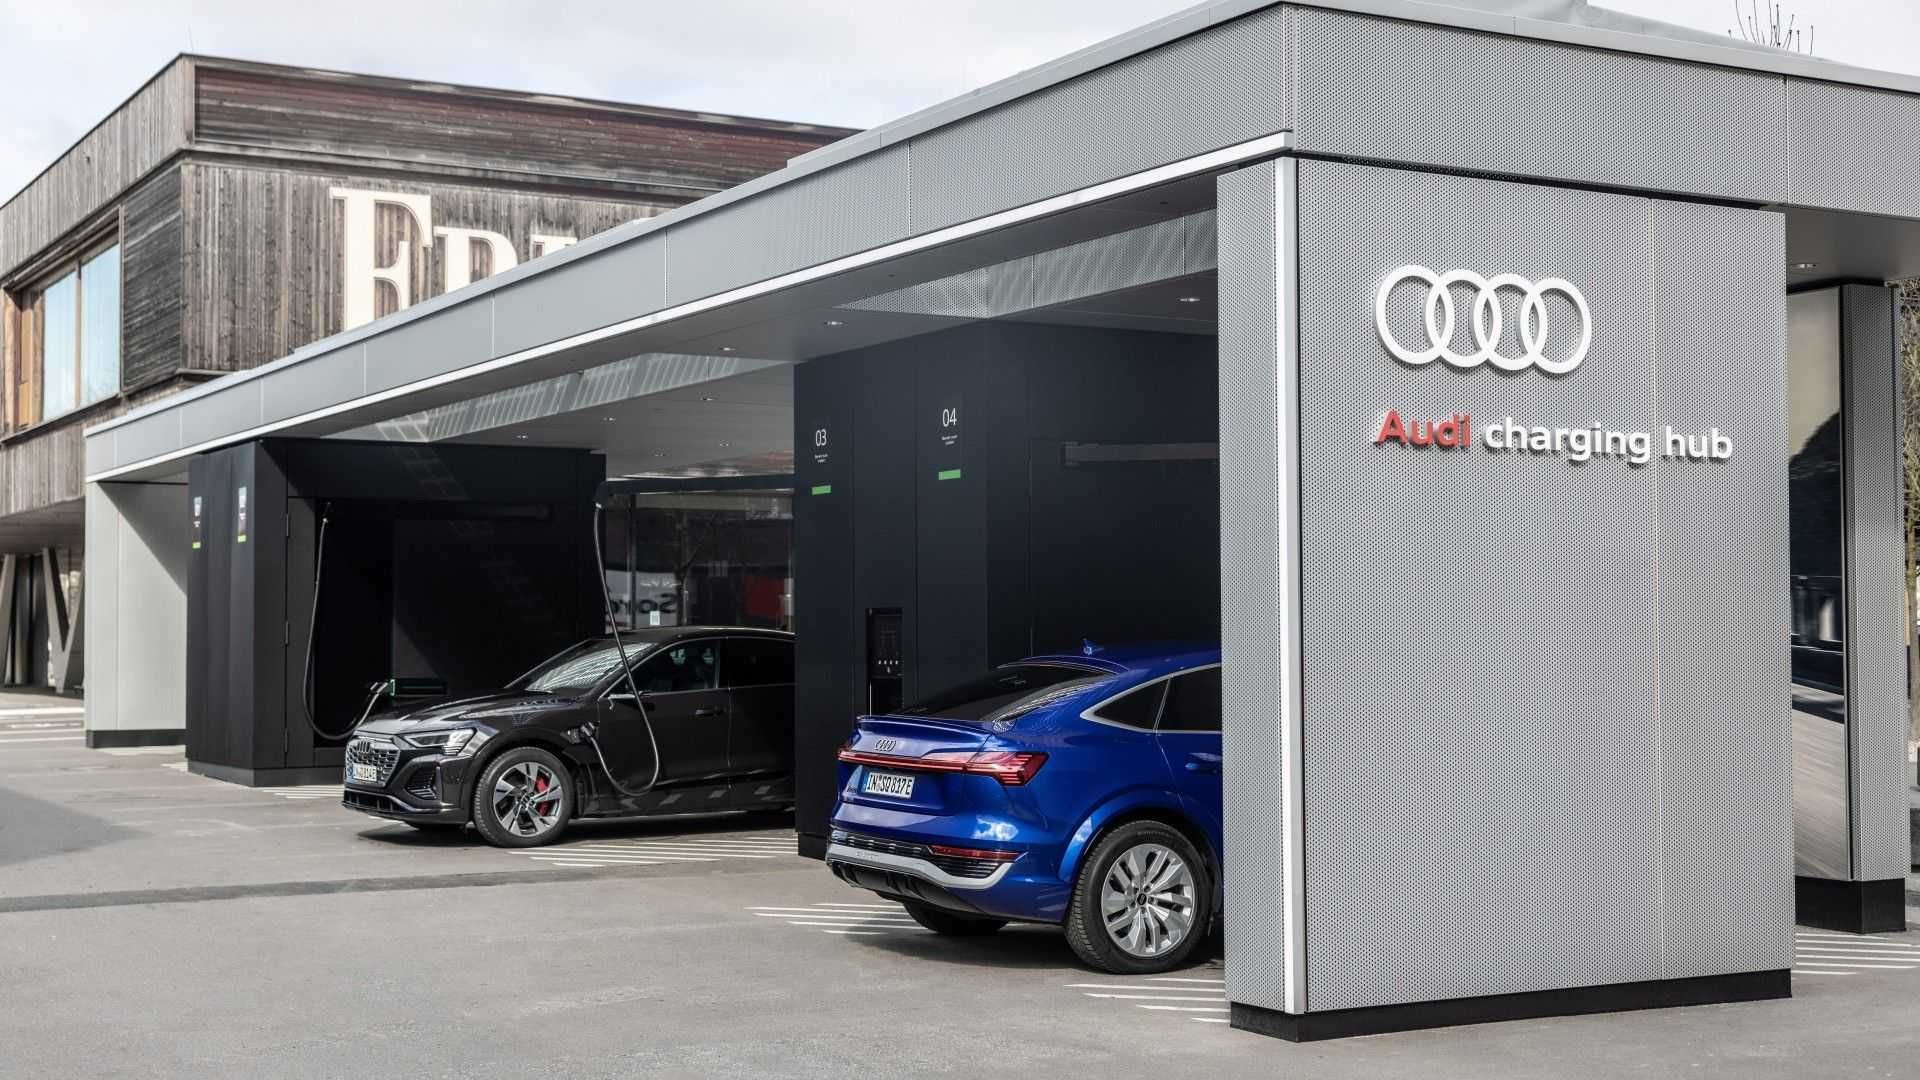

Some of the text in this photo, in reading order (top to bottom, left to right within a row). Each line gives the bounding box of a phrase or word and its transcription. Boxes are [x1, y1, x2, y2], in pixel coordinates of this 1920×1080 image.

[942, 407, 957, 428] 04
[815, 429, 827, 447] 03
[1377, 409, 1733, 464] Audi charging hub
